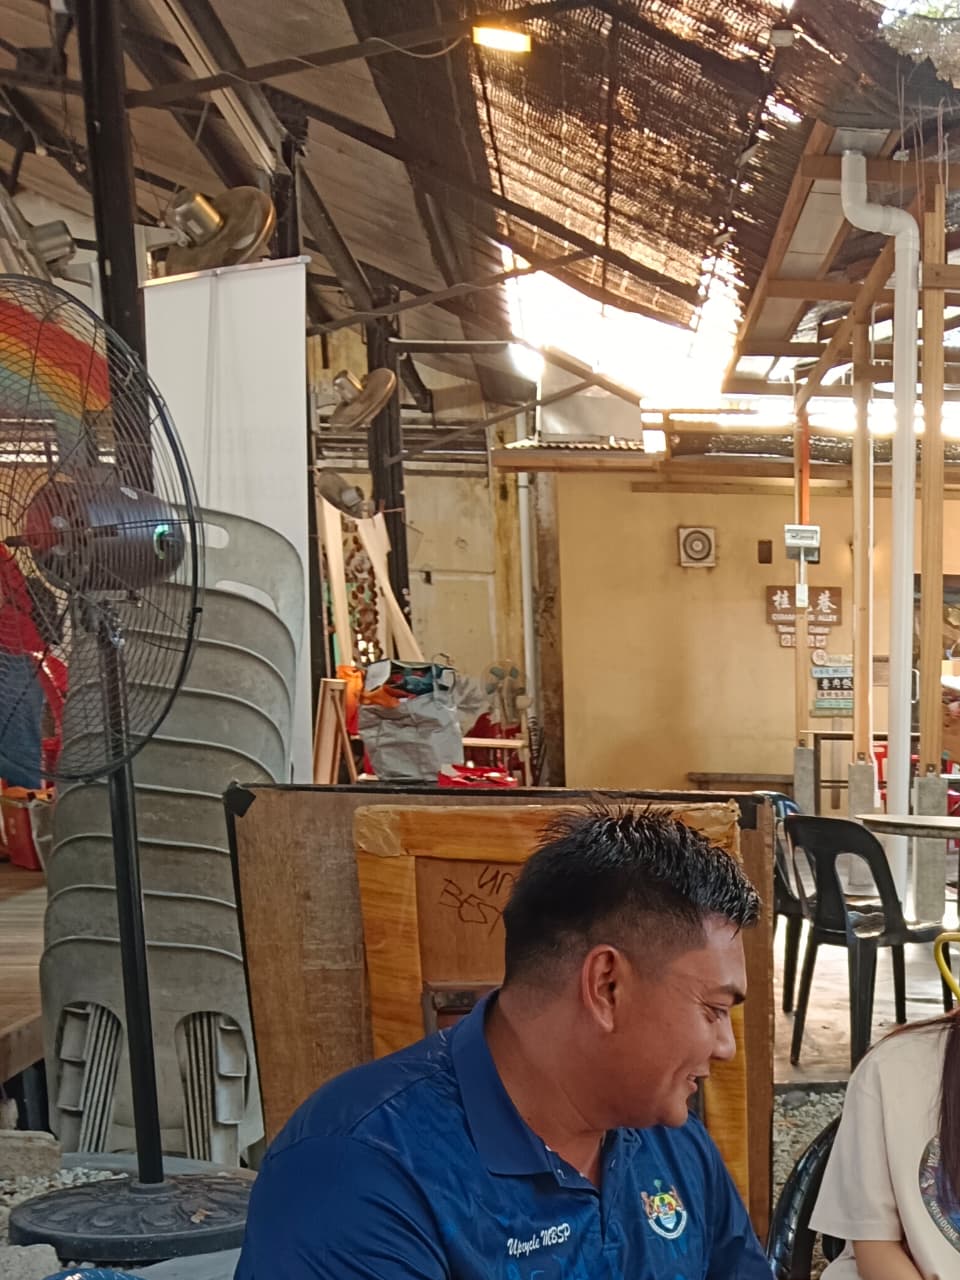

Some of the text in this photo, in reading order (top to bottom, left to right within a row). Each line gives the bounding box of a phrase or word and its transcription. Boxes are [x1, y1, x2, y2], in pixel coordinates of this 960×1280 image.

[772, 590, 837, 612] 桂巷
[507, 1222, 570, 1258] Upcycle MBSP
